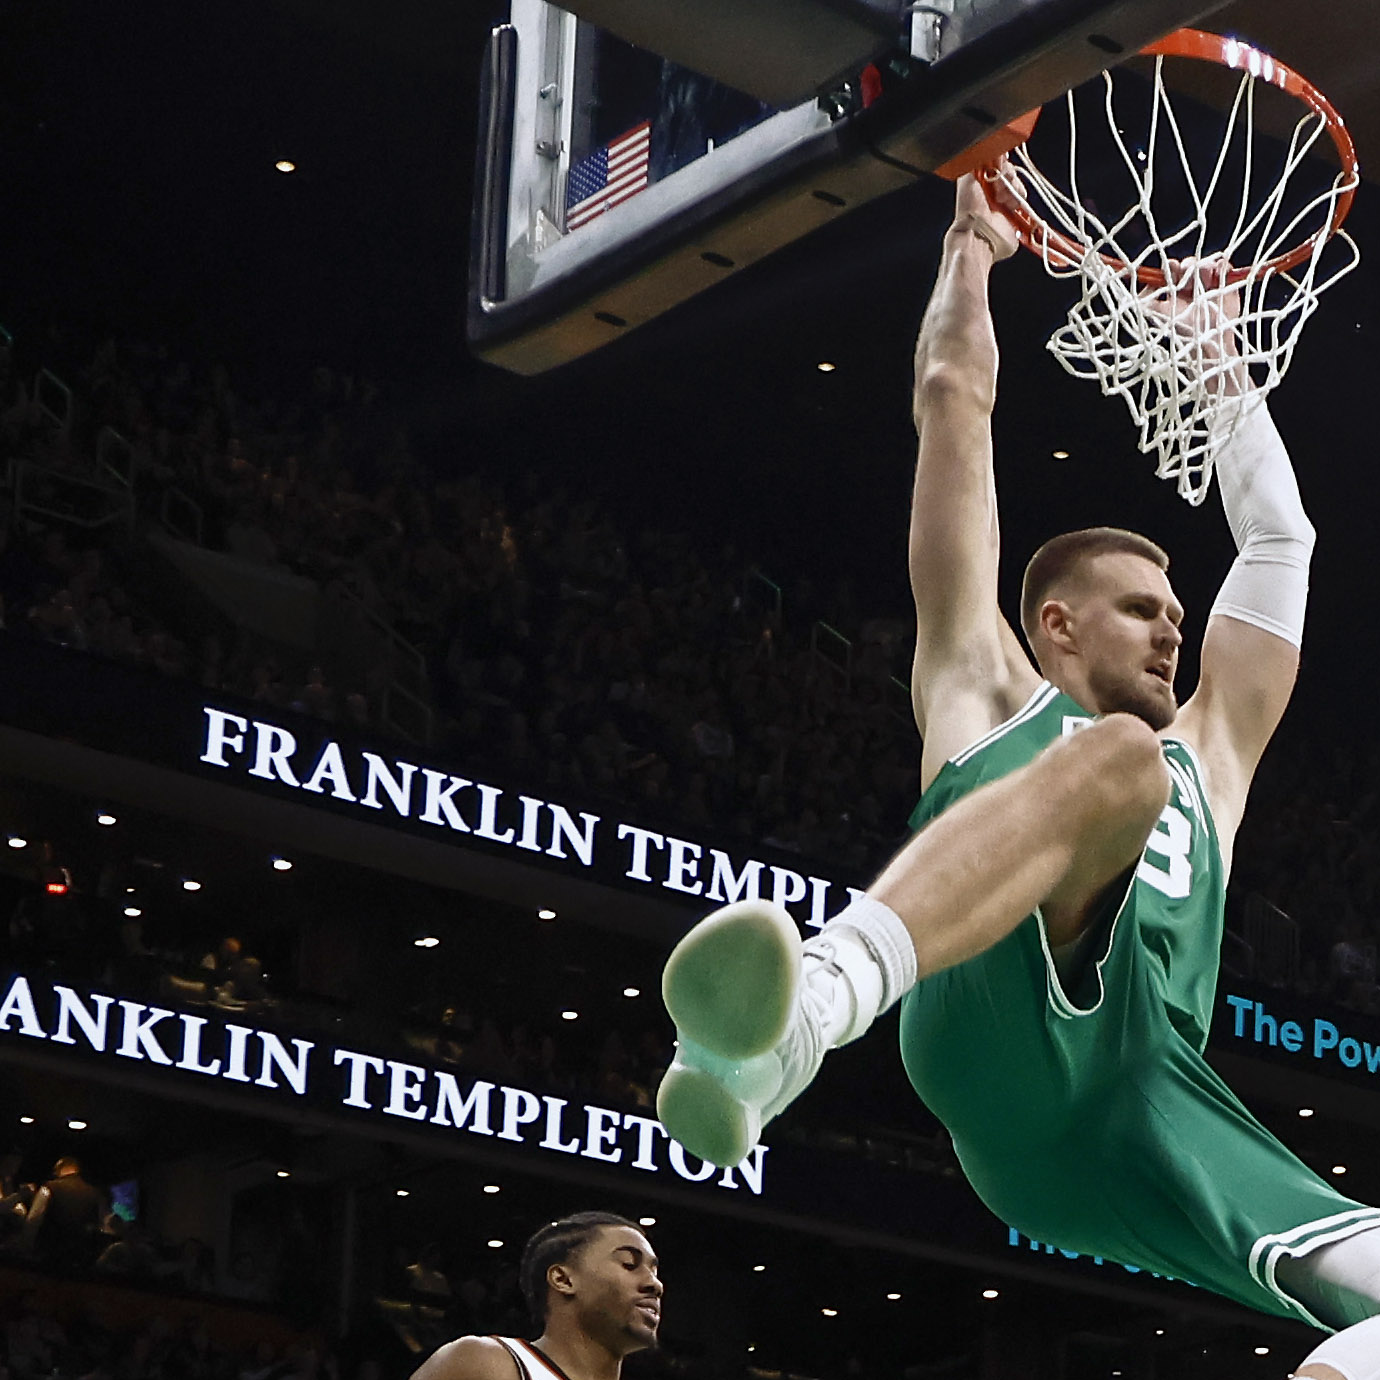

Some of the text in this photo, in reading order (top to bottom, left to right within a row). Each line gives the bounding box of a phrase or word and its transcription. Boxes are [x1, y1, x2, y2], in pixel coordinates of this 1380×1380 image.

[200, 706, 869, 929] FRANKLIN TEMPL
[1227, 995, 1302, 1052] The
